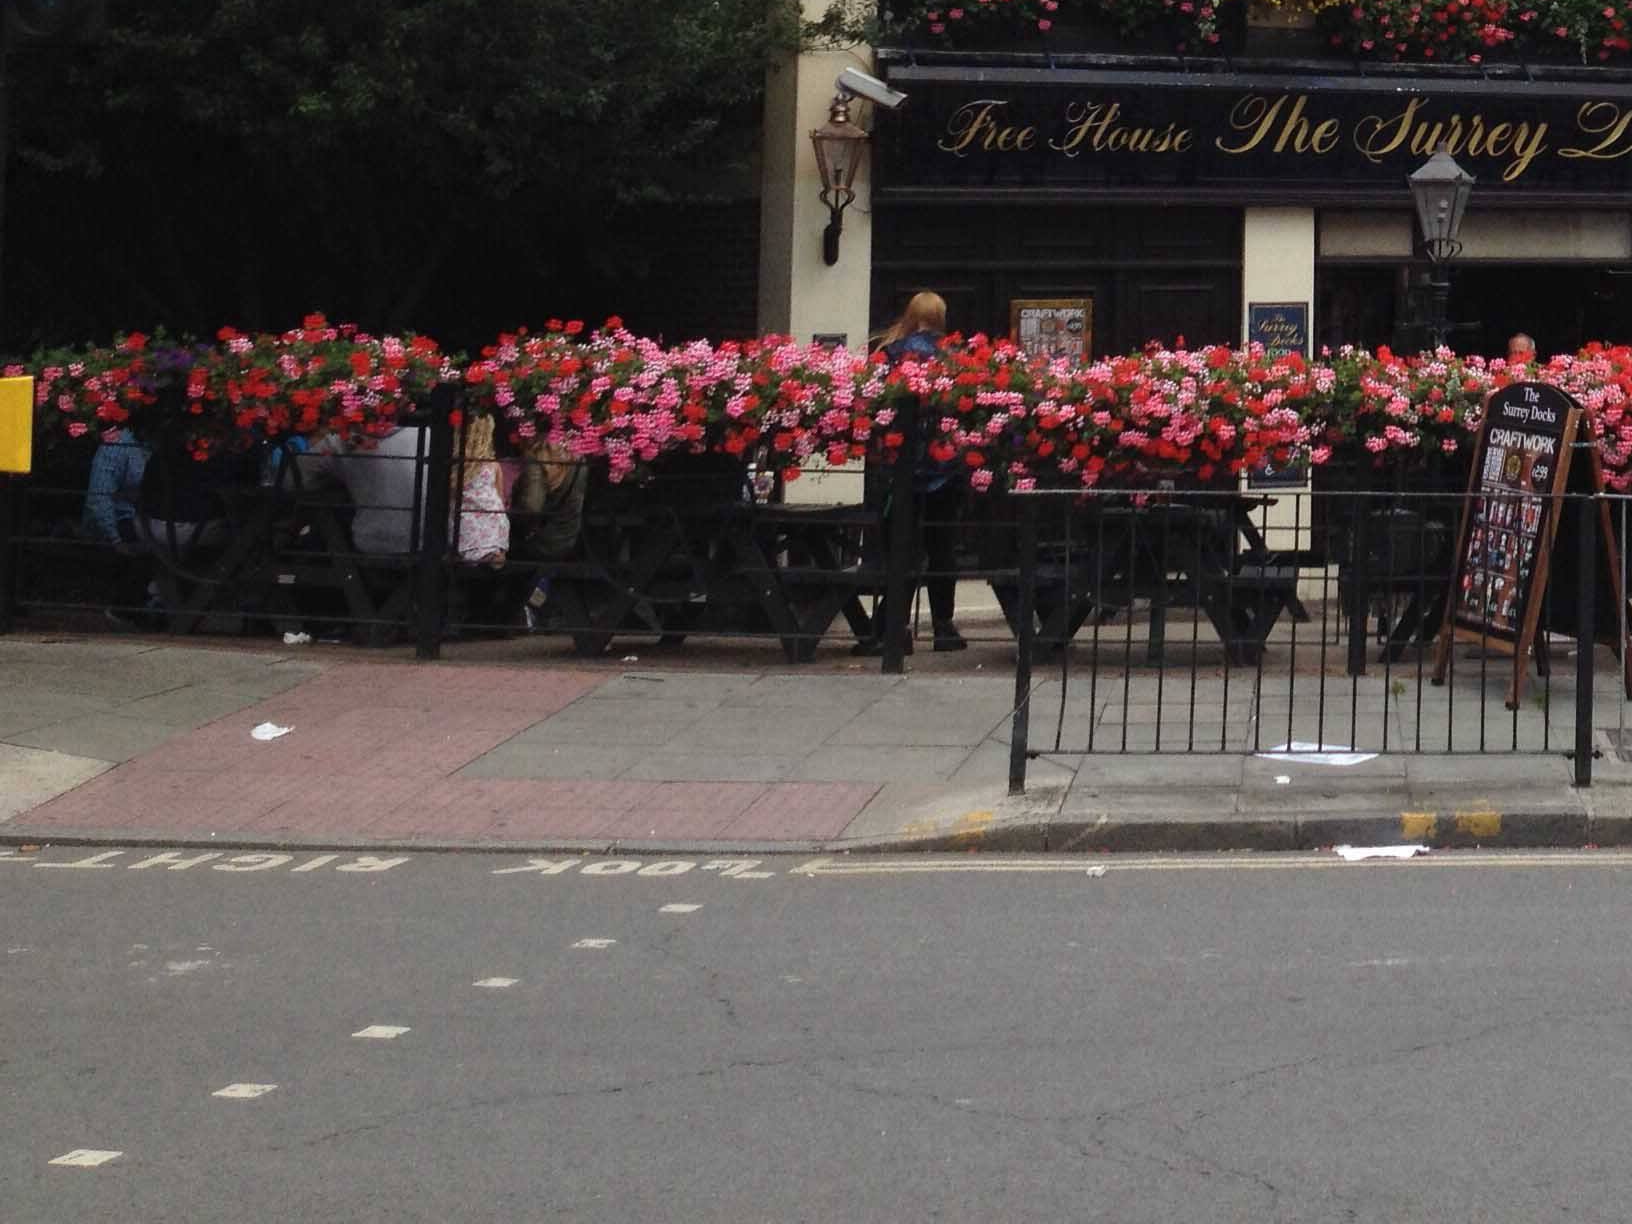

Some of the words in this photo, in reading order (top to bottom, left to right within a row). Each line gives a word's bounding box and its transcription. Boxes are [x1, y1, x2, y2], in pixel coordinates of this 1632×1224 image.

[937, 99, 1035, 158] Free
[1048, 102, 1192, 158] House
[1215, 93, 1339, 155] The
[1354, 96, 1545, 181] Surrey
[1524, 387, 1540, 402] The
[1503, 401, 1530, 424] Surrey
[1531, 405, 1556, 423] Docks
[1489, 427, 1557, 455] CRAFTWORK
[33, 851, 409, 872] RIGHT
[492, 859, 776, 879] LOOK
